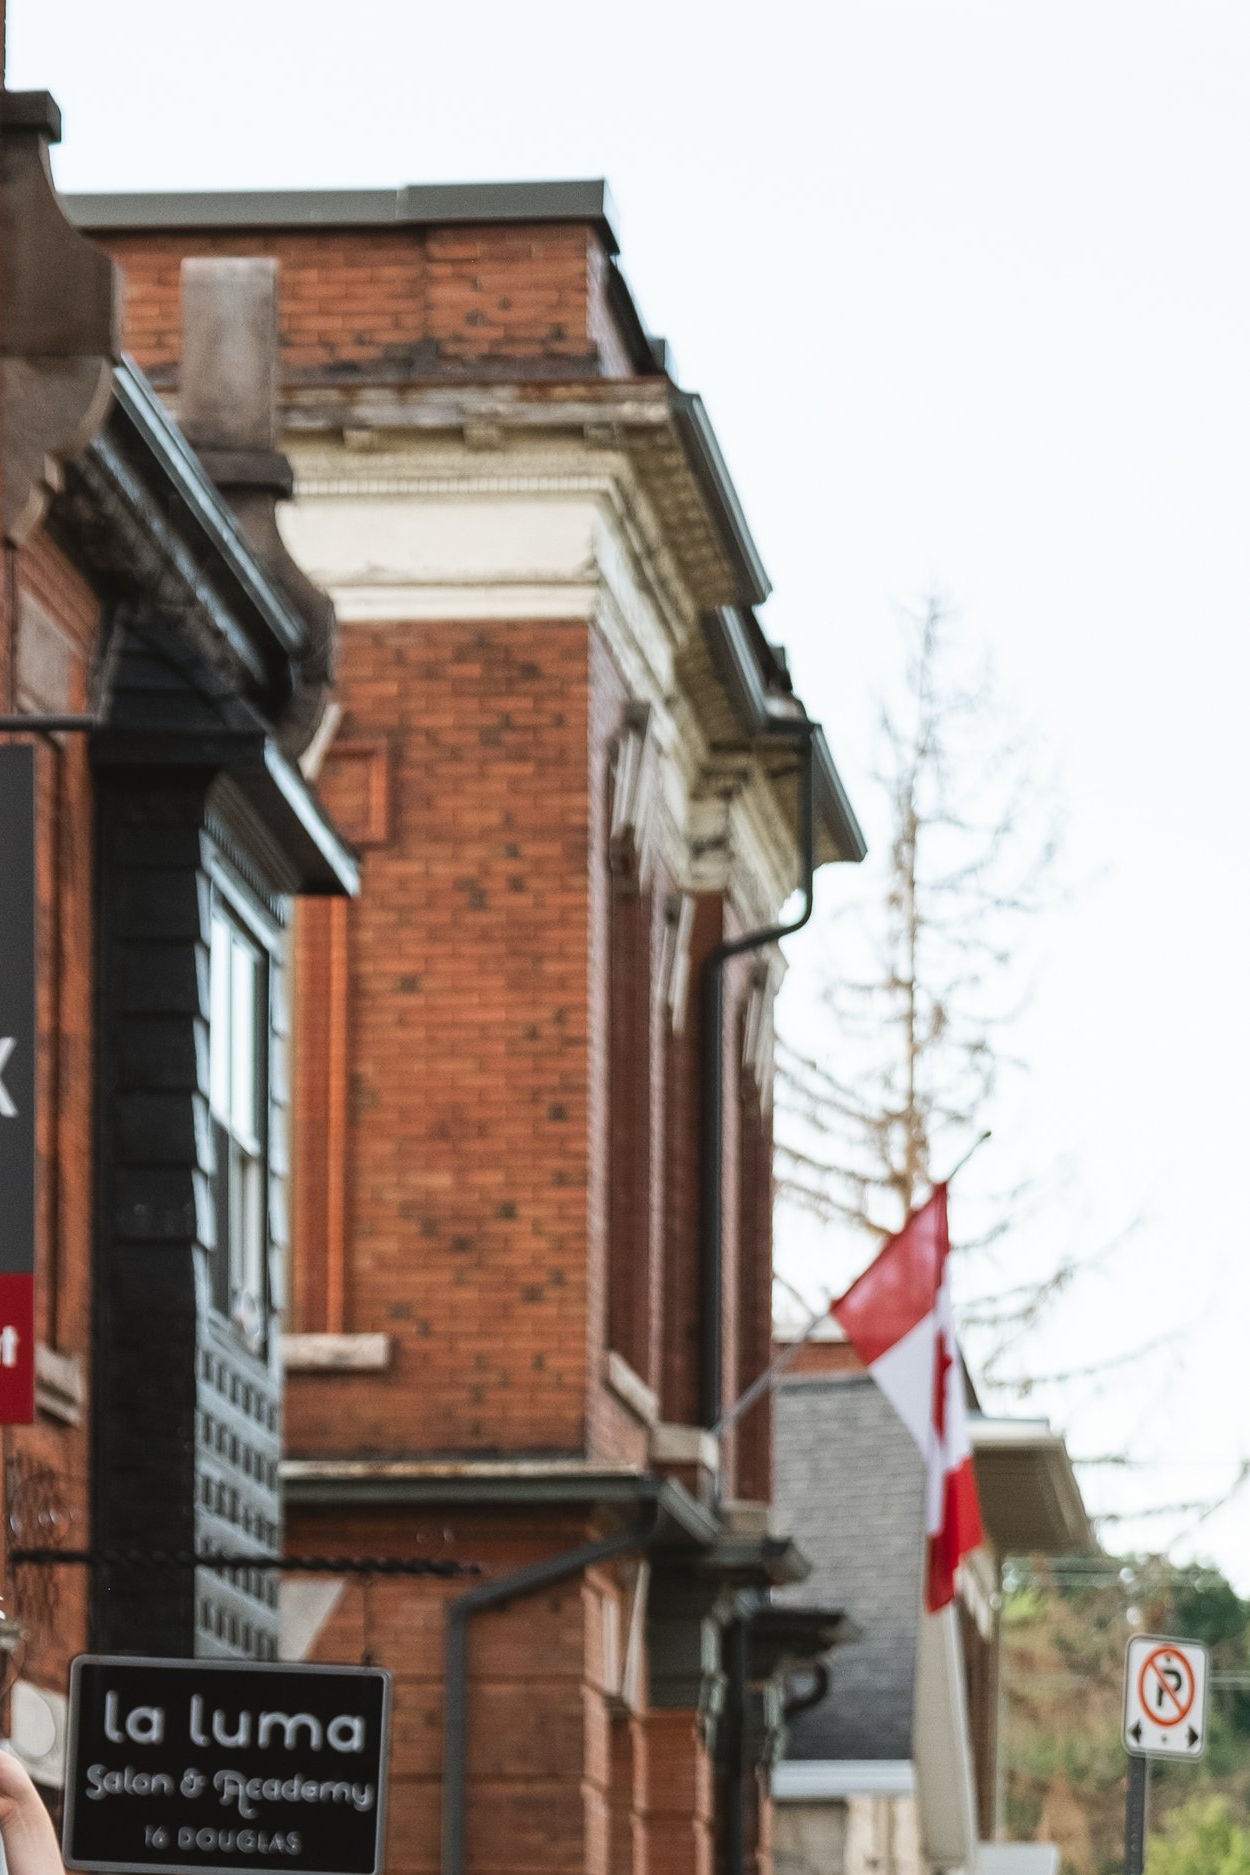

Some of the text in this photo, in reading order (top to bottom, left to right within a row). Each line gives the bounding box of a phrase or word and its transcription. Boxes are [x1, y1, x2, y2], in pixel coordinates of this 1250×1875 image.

[104, 1690, 366, 1753] la luma
[85, 1763, 375, 1819] Salon & Academy
[144, 1825, 302, 1856] 16 DOUGLAS
